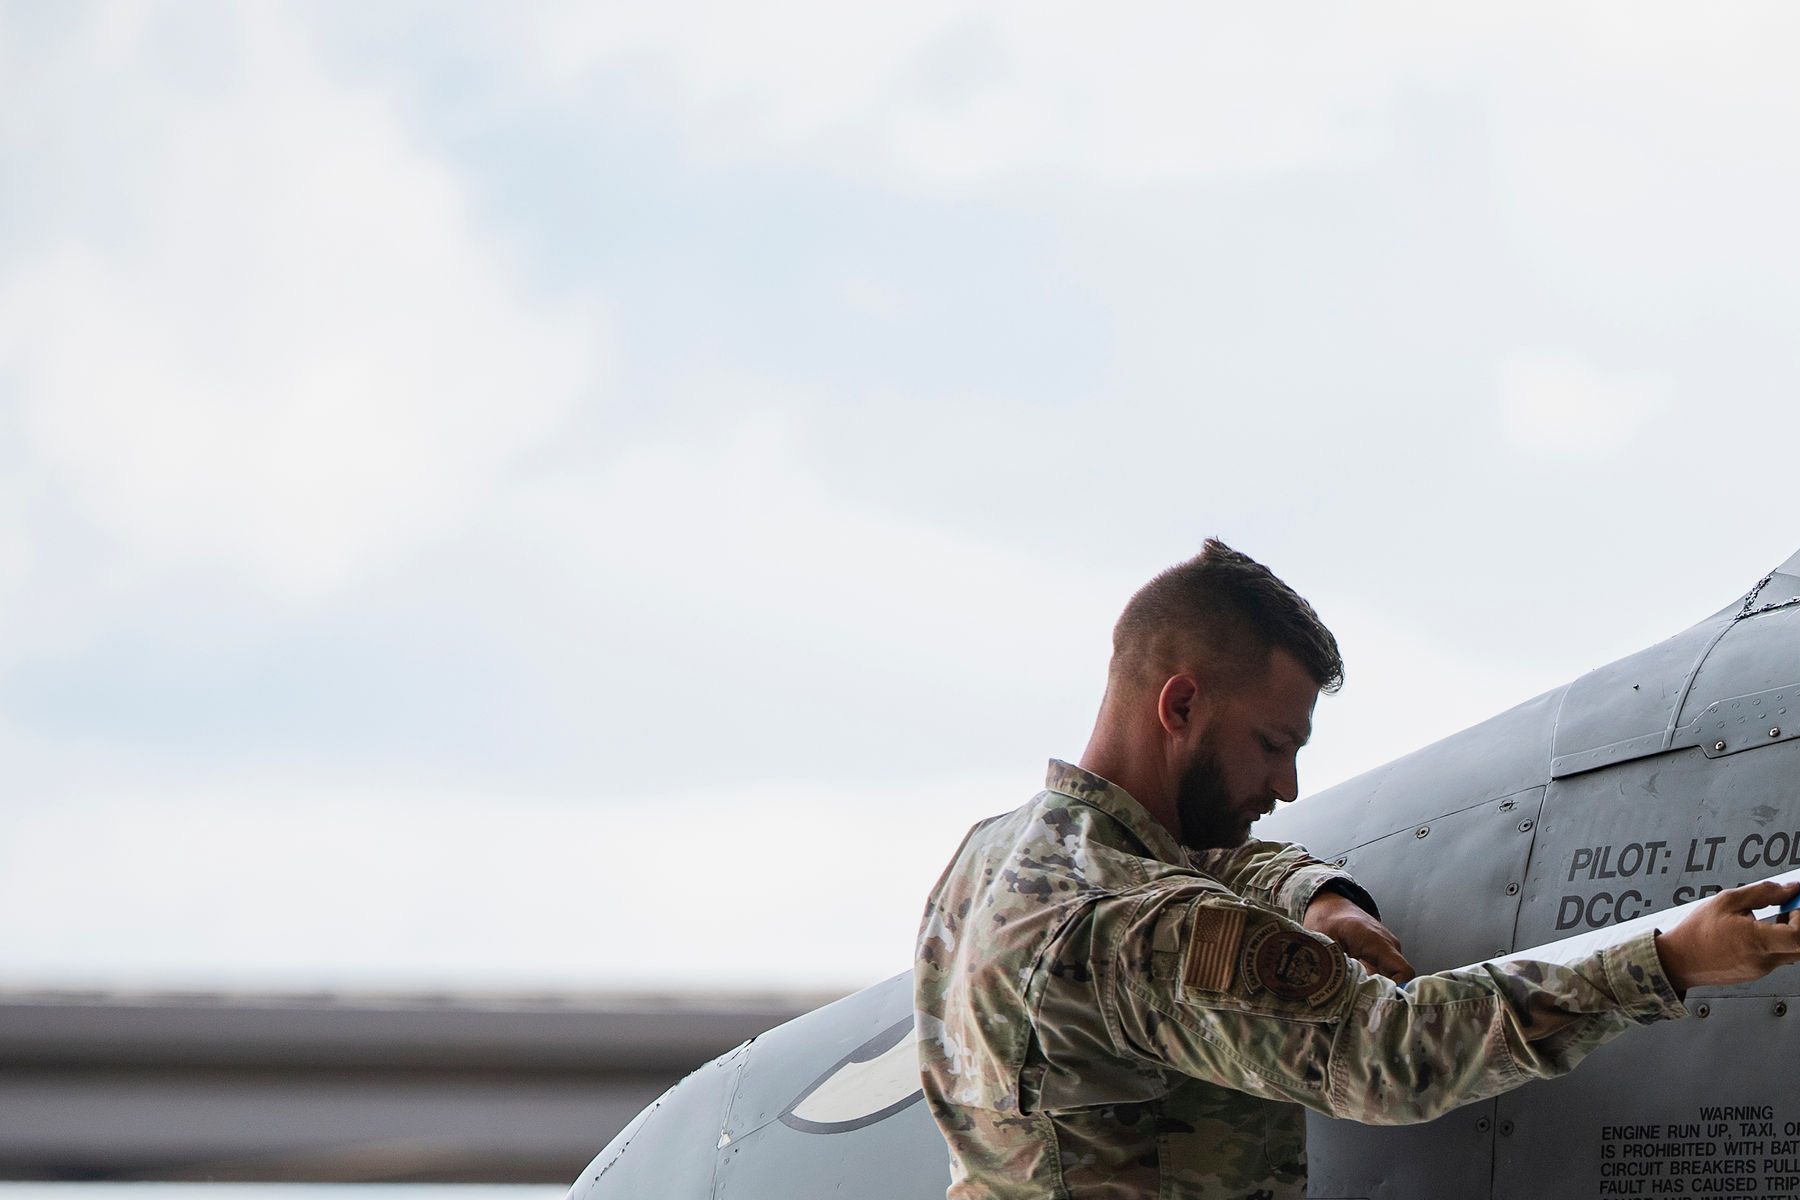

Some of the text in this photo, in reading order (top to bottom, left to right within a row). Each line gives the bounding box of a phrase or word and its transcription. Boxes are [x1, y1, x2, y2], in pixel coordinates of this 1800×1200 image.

[1567, 840, 1672, 882] PILOT:
[1685, 836, 1726, 873] LT
[1554, 889, 1652, 931] DCC:
[1699, 1105, 1774, 1121] WARNING
[1601, 1125, 1660, 1141] ENGINE
[1667, 1124, 1700, 1139] RUN
[1707, 1123, 1732, 1141] UP,
[1739, 1122, 1777, 1139] TAXI,
[1601, 1144, 1615, 1159] IS
[1622, 1142, 1716, 1158] PROHIBITED
[1724, 1141, 1763, 1156] WITH
[1600, 1162, 1663, 1177] CIRCUIT
[1669, 1160, 1756, 1175] BREAKERS
[1600, 1179, 1646, 1194] FAULT
[1652, 1178, 1684, 1193] HAS
[1691, 1177, 1757, 1193] CAUSED
